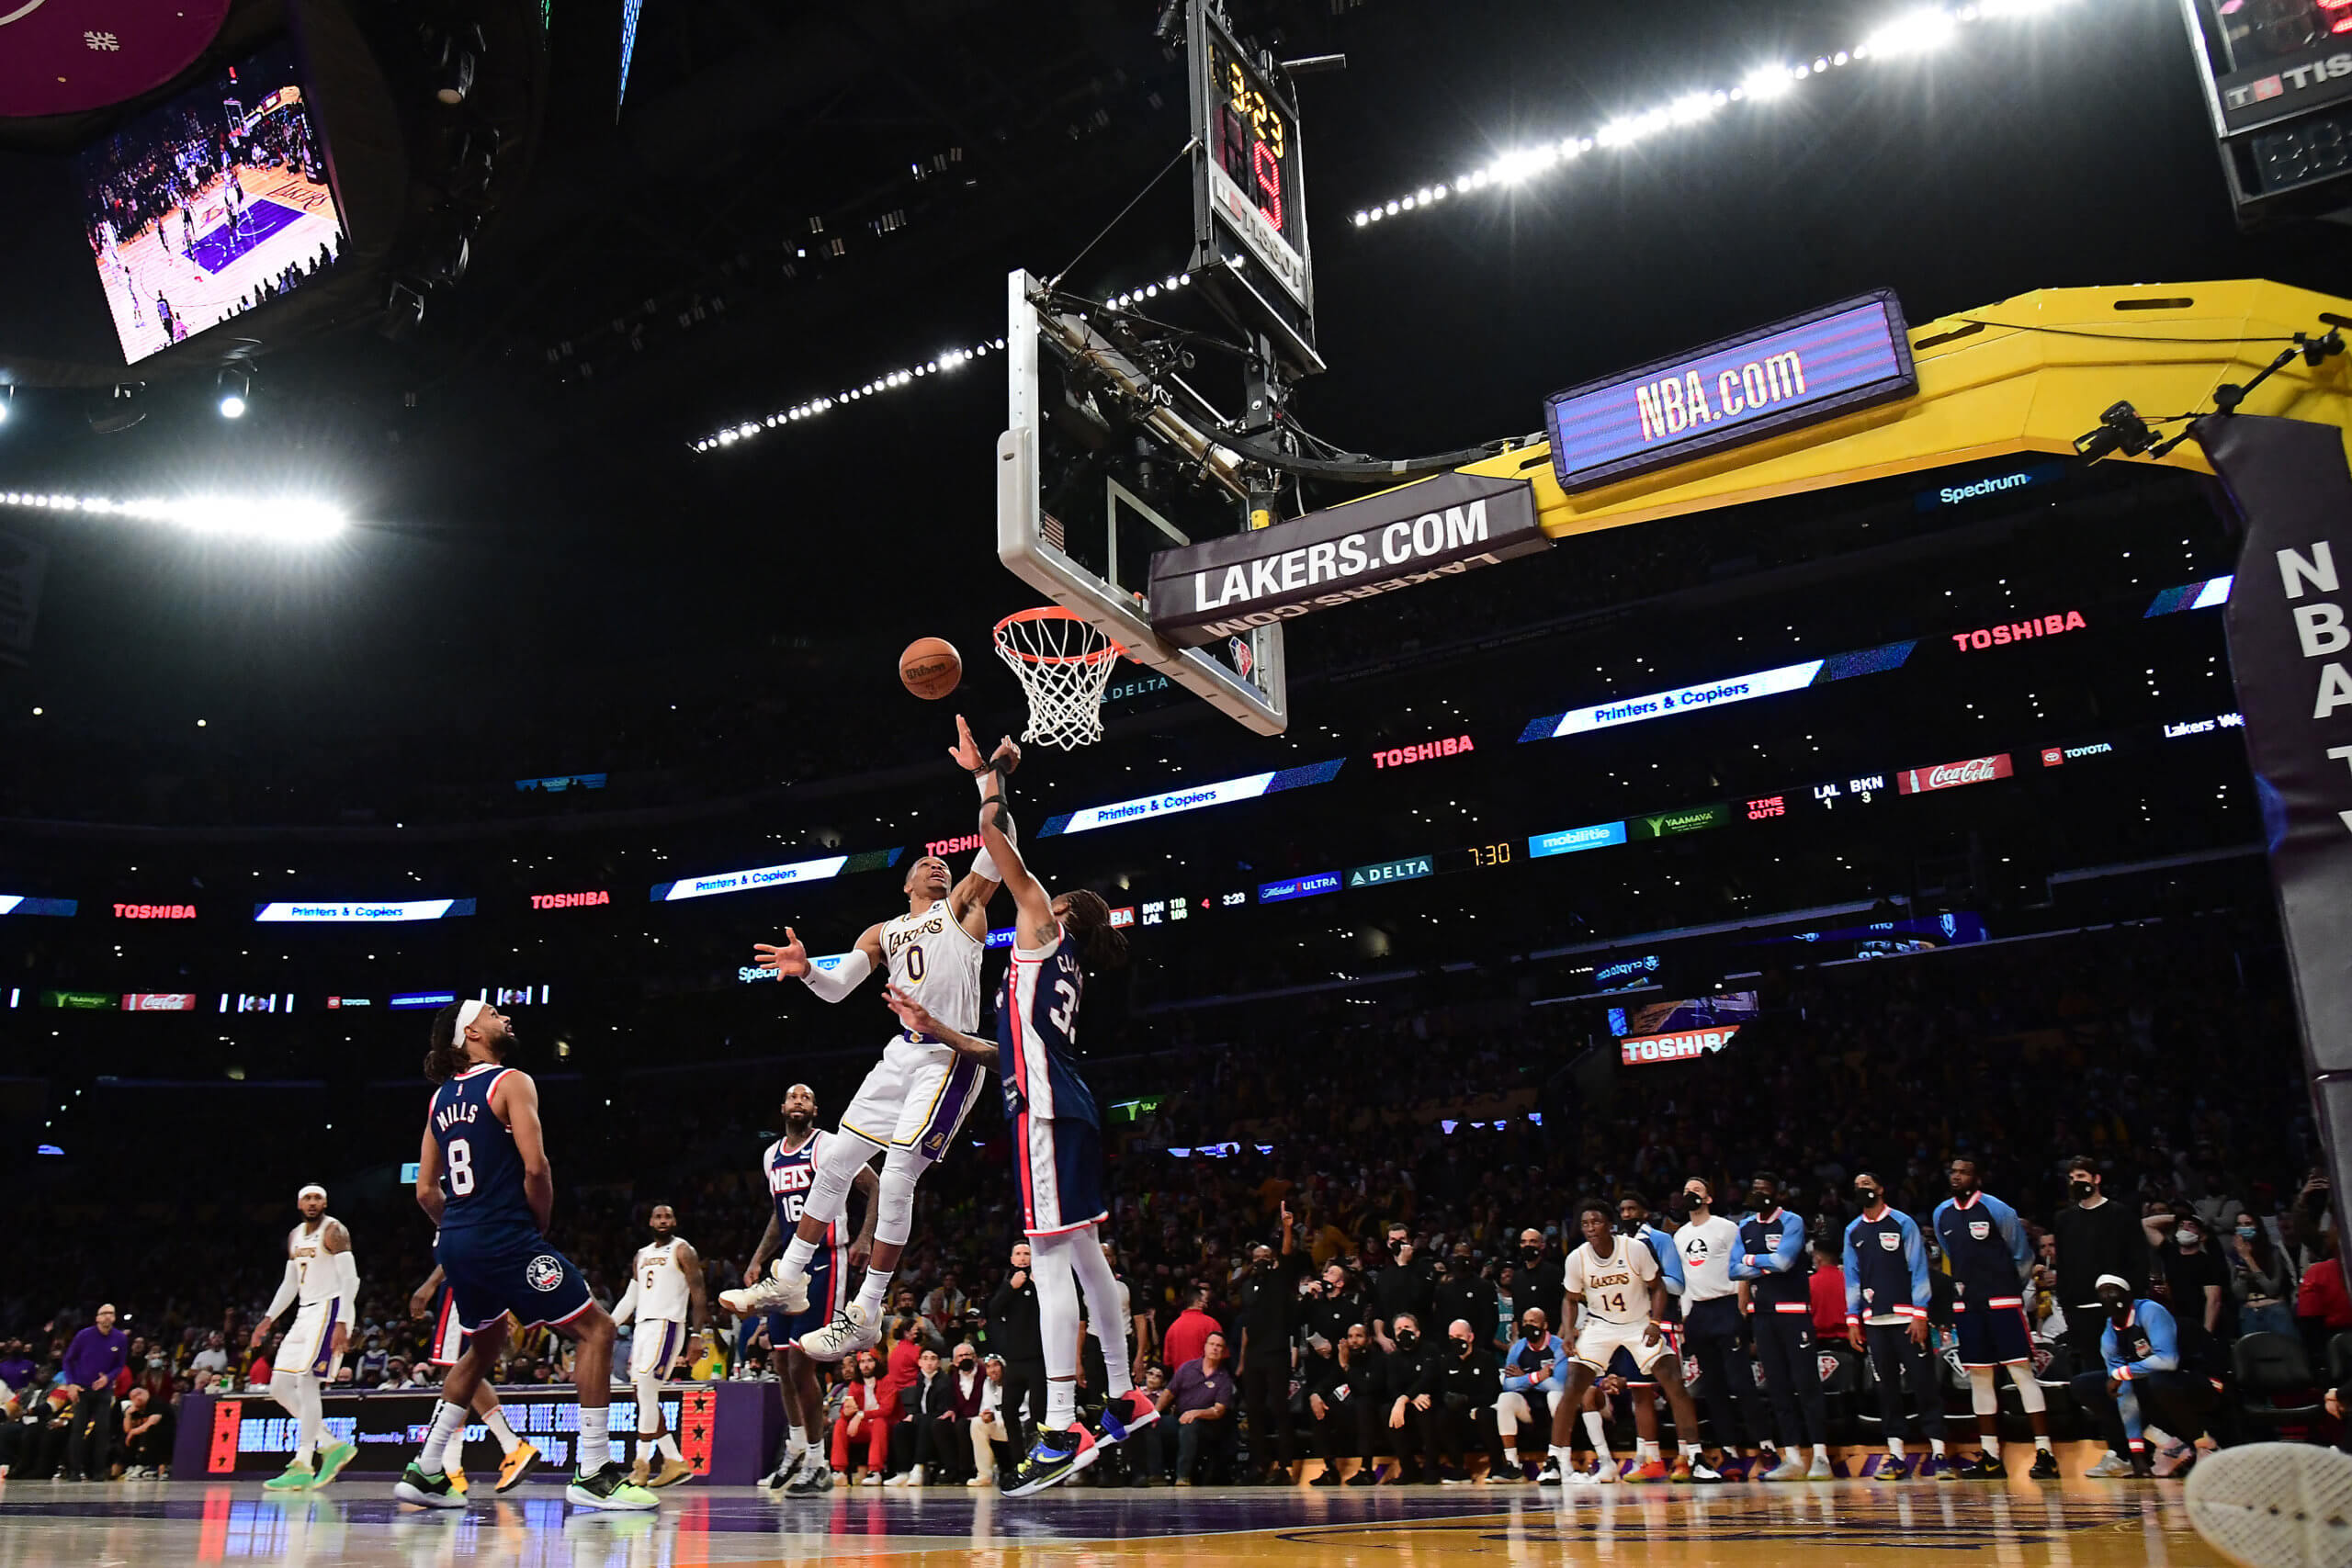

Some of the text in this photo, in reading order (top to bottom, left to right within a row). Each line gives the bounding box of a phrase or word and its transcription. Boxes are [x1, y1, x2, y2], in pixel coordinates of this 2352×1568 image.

[1241, 202, 1303, 288] TISSOT
[1635, 350, 1807, 443] NBA.com
[1939, 473, 2027, 503] Spectrum
[1195, 499, 1488, 612] LAKERS.COM
[1952, 610, 2086, 652] TOSHIBA
[1113, 677, 1169, 699] DELTA
[1595, 683, 1749, 723] Printers & Copiers
[2164, 720, 2215, 738] Lakers
[1373, 735, 1474, 768] TOSHIBA
[2064, 743, 2112, 759] TOYOTA
[1929, 757, 1996, 788] Coca-Cola
[1815, 776, 1883, 798] LAL BKN
[1098, 791, 1216, 822] Printers & Copiers
[1747, 796, 1783, 809] TIME
[1824, 792, 1871, 809] 1 3
[1747, 807, 1785, 819] OUTS
[1544, 829, 1610, 848] mobilitie
[1469, 843, 1511, 867] 7:30
[695, 879, 737, 892] Printers
[752, 868, 797, 883] Copiers
[1370, 861, 1430, 882] DELTA
[1303, 877, 1338, 891] ULTRA
[531, 890, 609, 909] TOSHIBA
[1143, 902, 1164, 915] BKN
[1201, 898, 1210, 908] 4
[1223, 893, 1246, 906] 3:23
[113, 903, 197, 919] TOSHIBA
[291, 907, 337, 918] Printers
[356, 906, 404, 919] Copiers
[888, 918, 943, 957] LAKERS
[906, 944, 927, 984] 0
[436, 1101, 479, 1133] MILLS
[447, 1138, 475, 1196] 8
[770, 1164, 811, 1192] NETS
[782, 1194, 804, 1223] 16
[300, 1262, 308, 1284] 7
[646, 1270, 654, 1289] 6
[1589, 1272, 1631, 1289] LAKERS
[1601, 1292, 1627, 1313] 14
